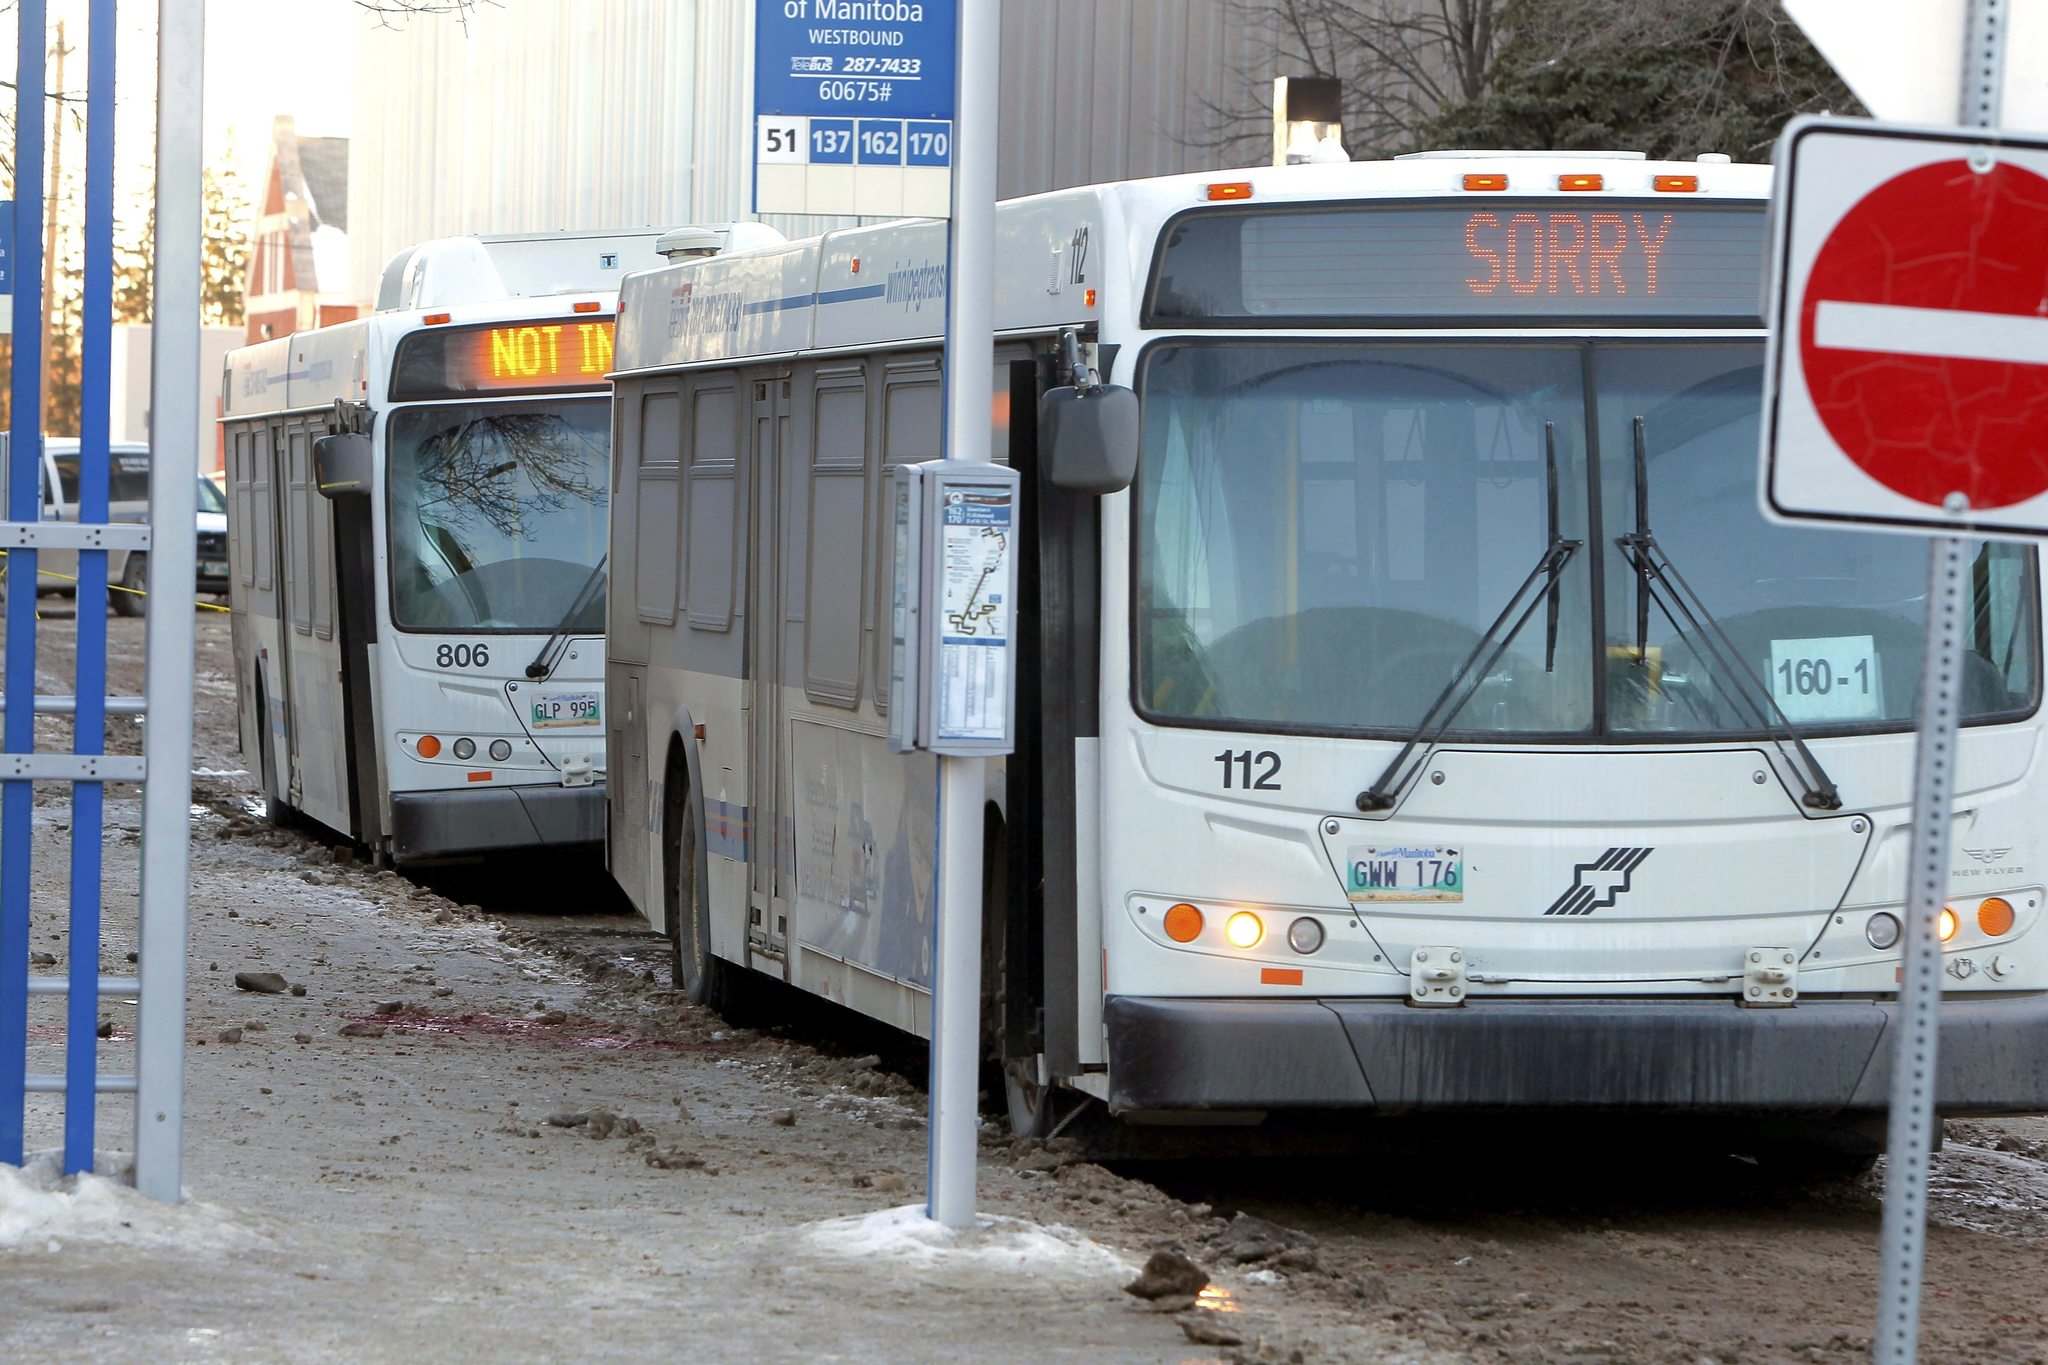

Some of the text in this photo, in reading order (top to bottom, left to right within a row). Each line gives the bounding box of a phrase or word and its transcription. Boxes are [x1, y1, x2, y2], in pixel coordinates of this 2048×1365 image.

[784, 0, 923, 22] of Manitoba
[808, 29, 904, 46] WESTBOUND
[843, 57, 921, 74] 287-7433
[819, 81, 892, 101] 60675#
[767, 128, 948, 156] 51 137 162 170
[1070, 226, 1088, 285] 112
[1464, 212, 1674, 294] SORRY
[491, 323, 616, 377] NOT IN
[436, 643, 489, 667] 806
[1777, 658, 1869, 695] 160-1
[535, 700, 597, 720] GLP 995
[1214, 749, 1282, 791] 112
[1353, 860, 1458, 888] GWW 176
[1951, 866, 2024, 877] NEW FLYER
